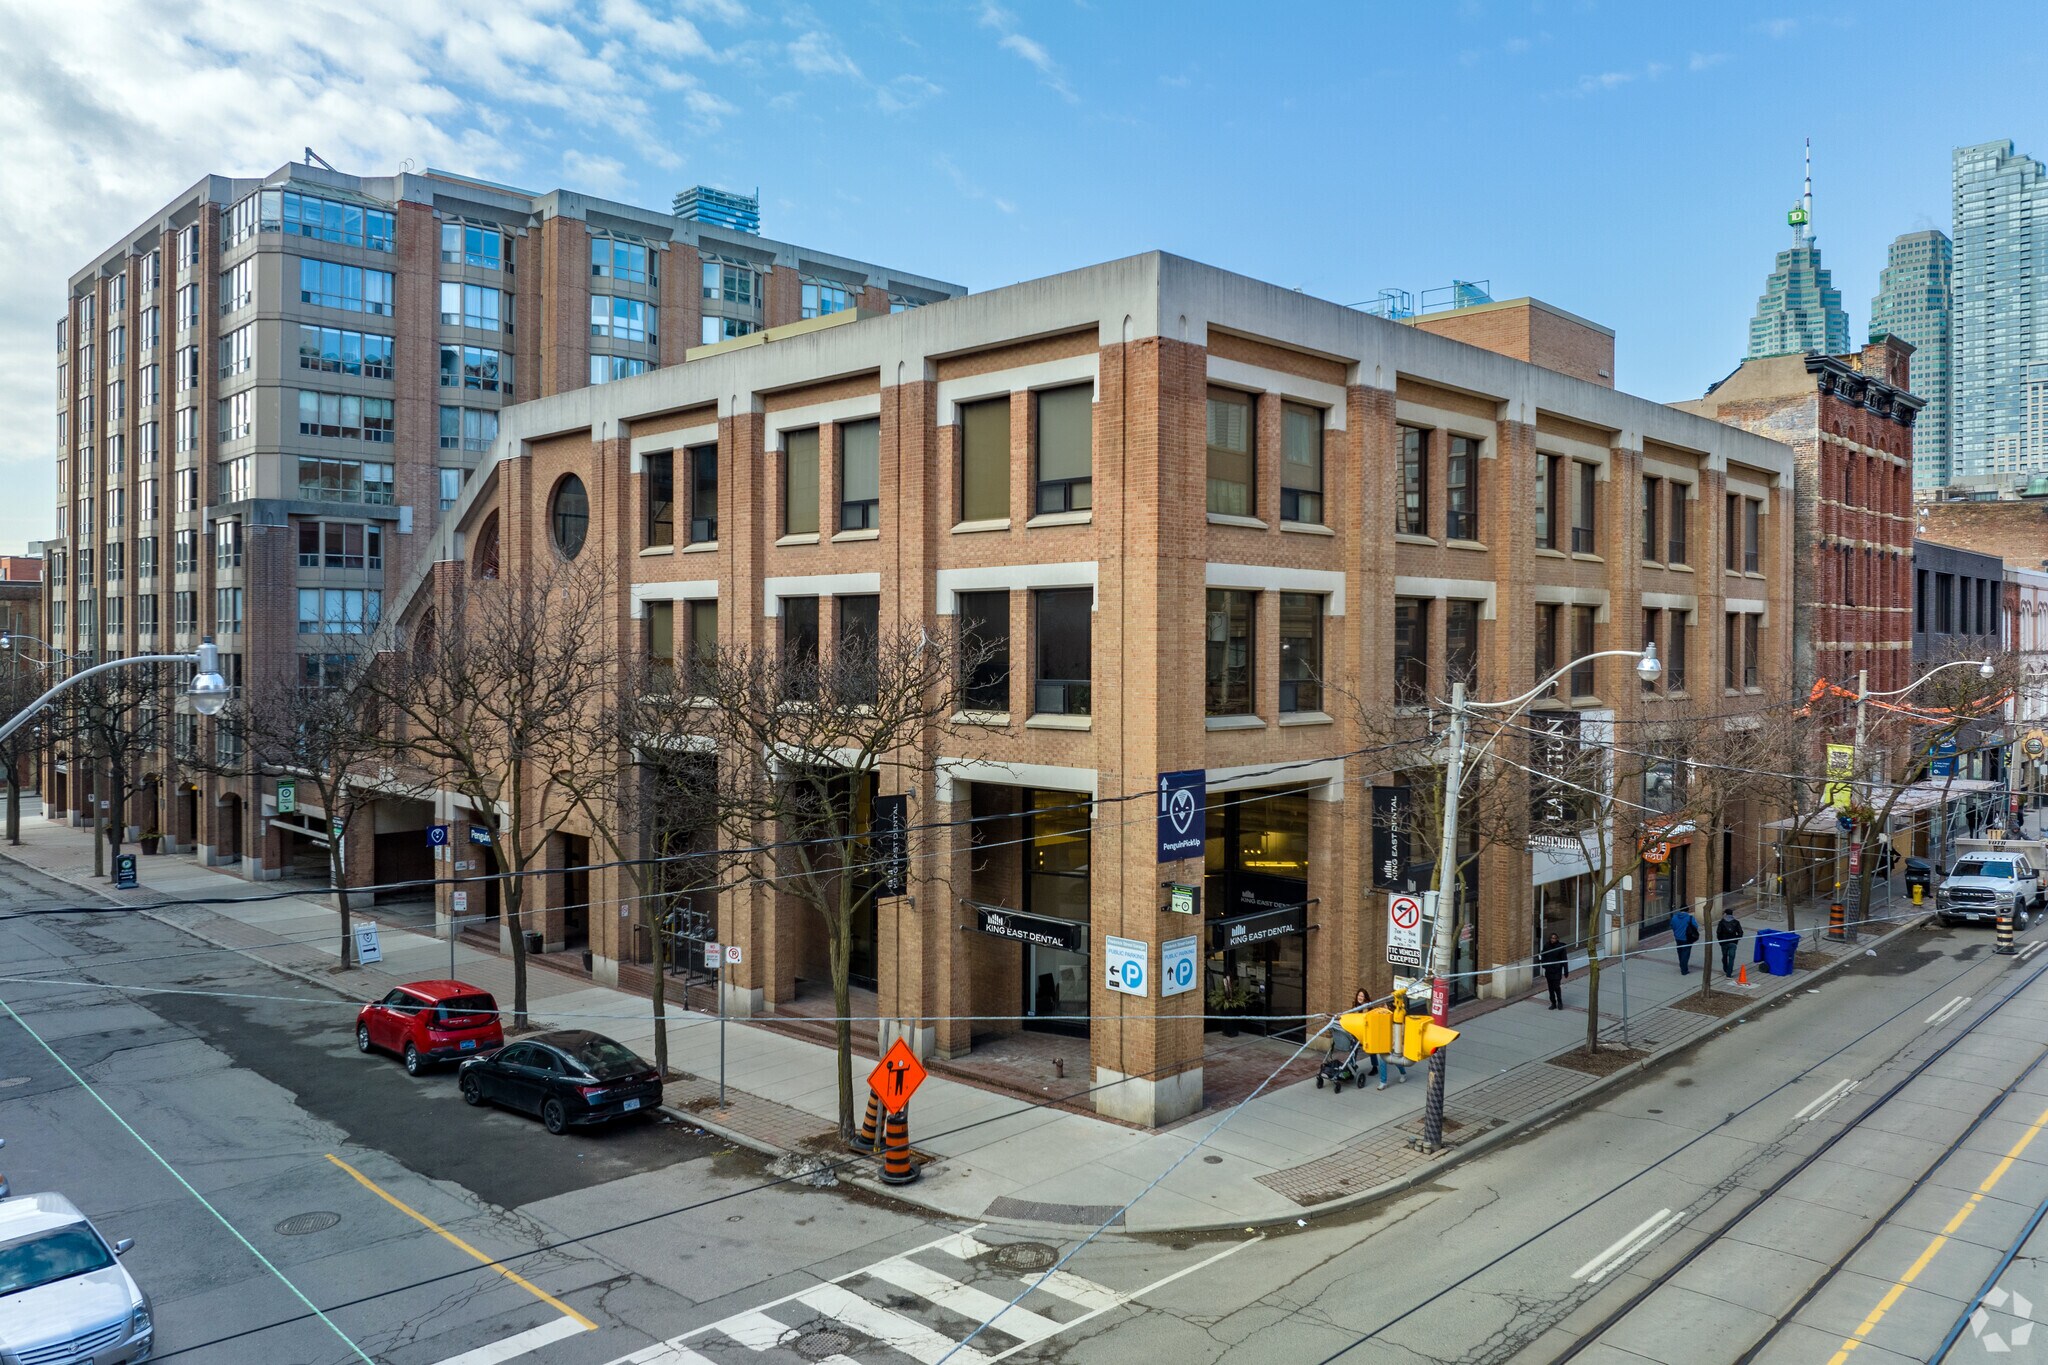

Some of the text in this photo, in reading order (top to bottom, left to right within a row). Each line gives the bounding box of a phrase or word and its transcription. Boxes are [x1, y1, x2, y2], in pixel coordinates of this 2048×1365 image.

[1789, 211, 1802, 221] TD
[1163, 838, 1201, 851] PenguinPickUp
[1256, 899, 1273, 907] EAST
[985, 924, 1064, 947] KING EAST DENTAL
[1229, 924, 1295, 946] KING EAST DENTAL
[1108, 948, 1145, 960] PUBLIC PARKING
[1178, 948, 1195, 956] PARKING
[1398, 948, 1420, 957] VEHICLES
[1389, 954, 1419, 964] EXCEPTED
[1126, 963, 1139, 985] P
[1179, 961, 1190, 984] P
